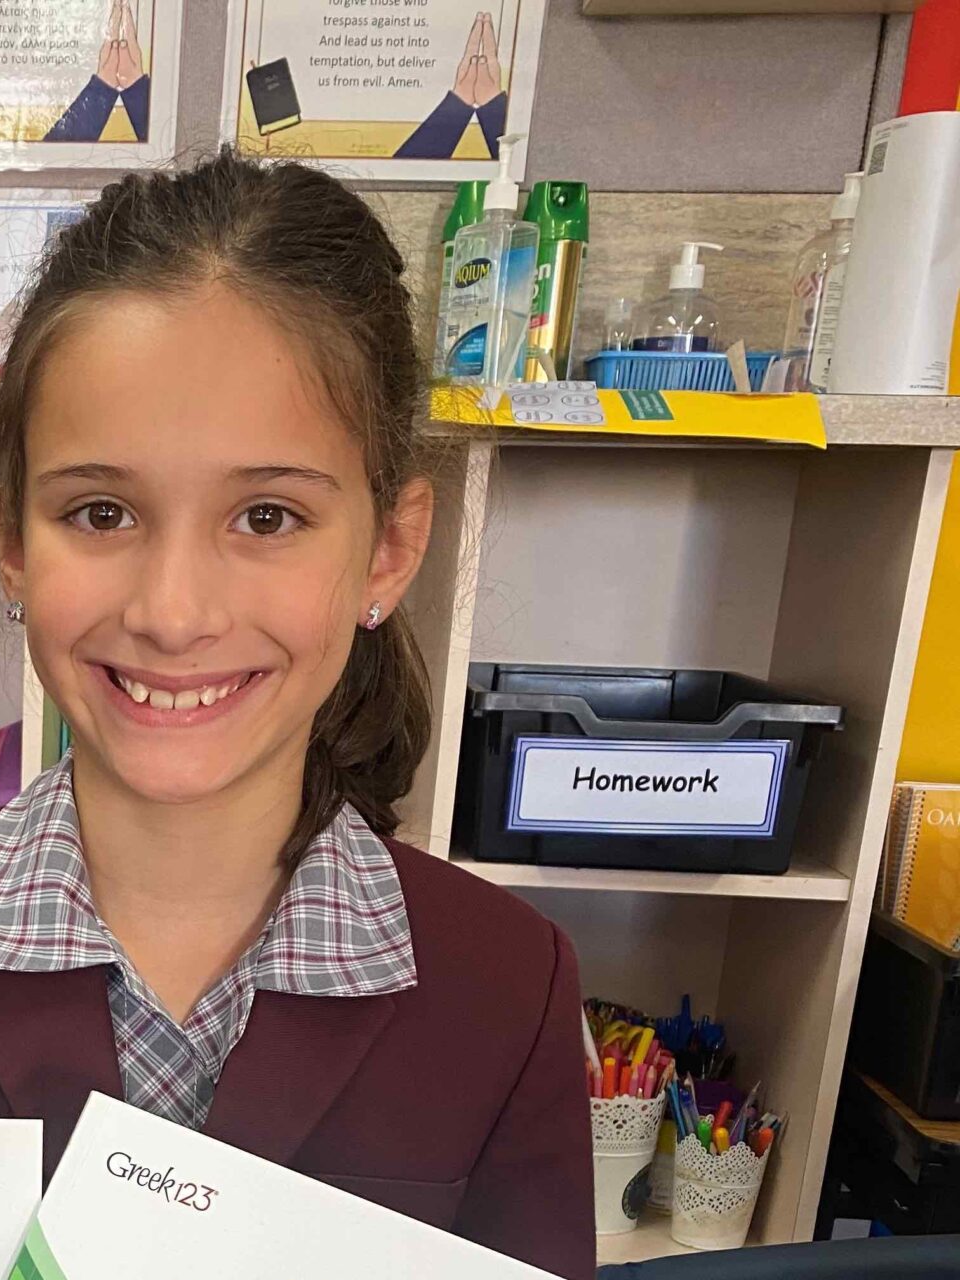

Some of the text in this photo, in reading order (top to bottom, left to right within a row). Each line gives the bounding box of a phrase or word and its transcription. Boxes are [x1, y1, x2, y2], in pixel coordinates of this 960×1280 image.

[323, 15, 429, 28] trespass against us.
[319, 34, 430, 48] And lead us not into
[309, 55, 437, 69] temptation, but deliver
[318, 74, 423, 88] us from evil. Amen.
[455, 263, 491, 284] AQIUM
[572, 766, 720, 794] Homework
